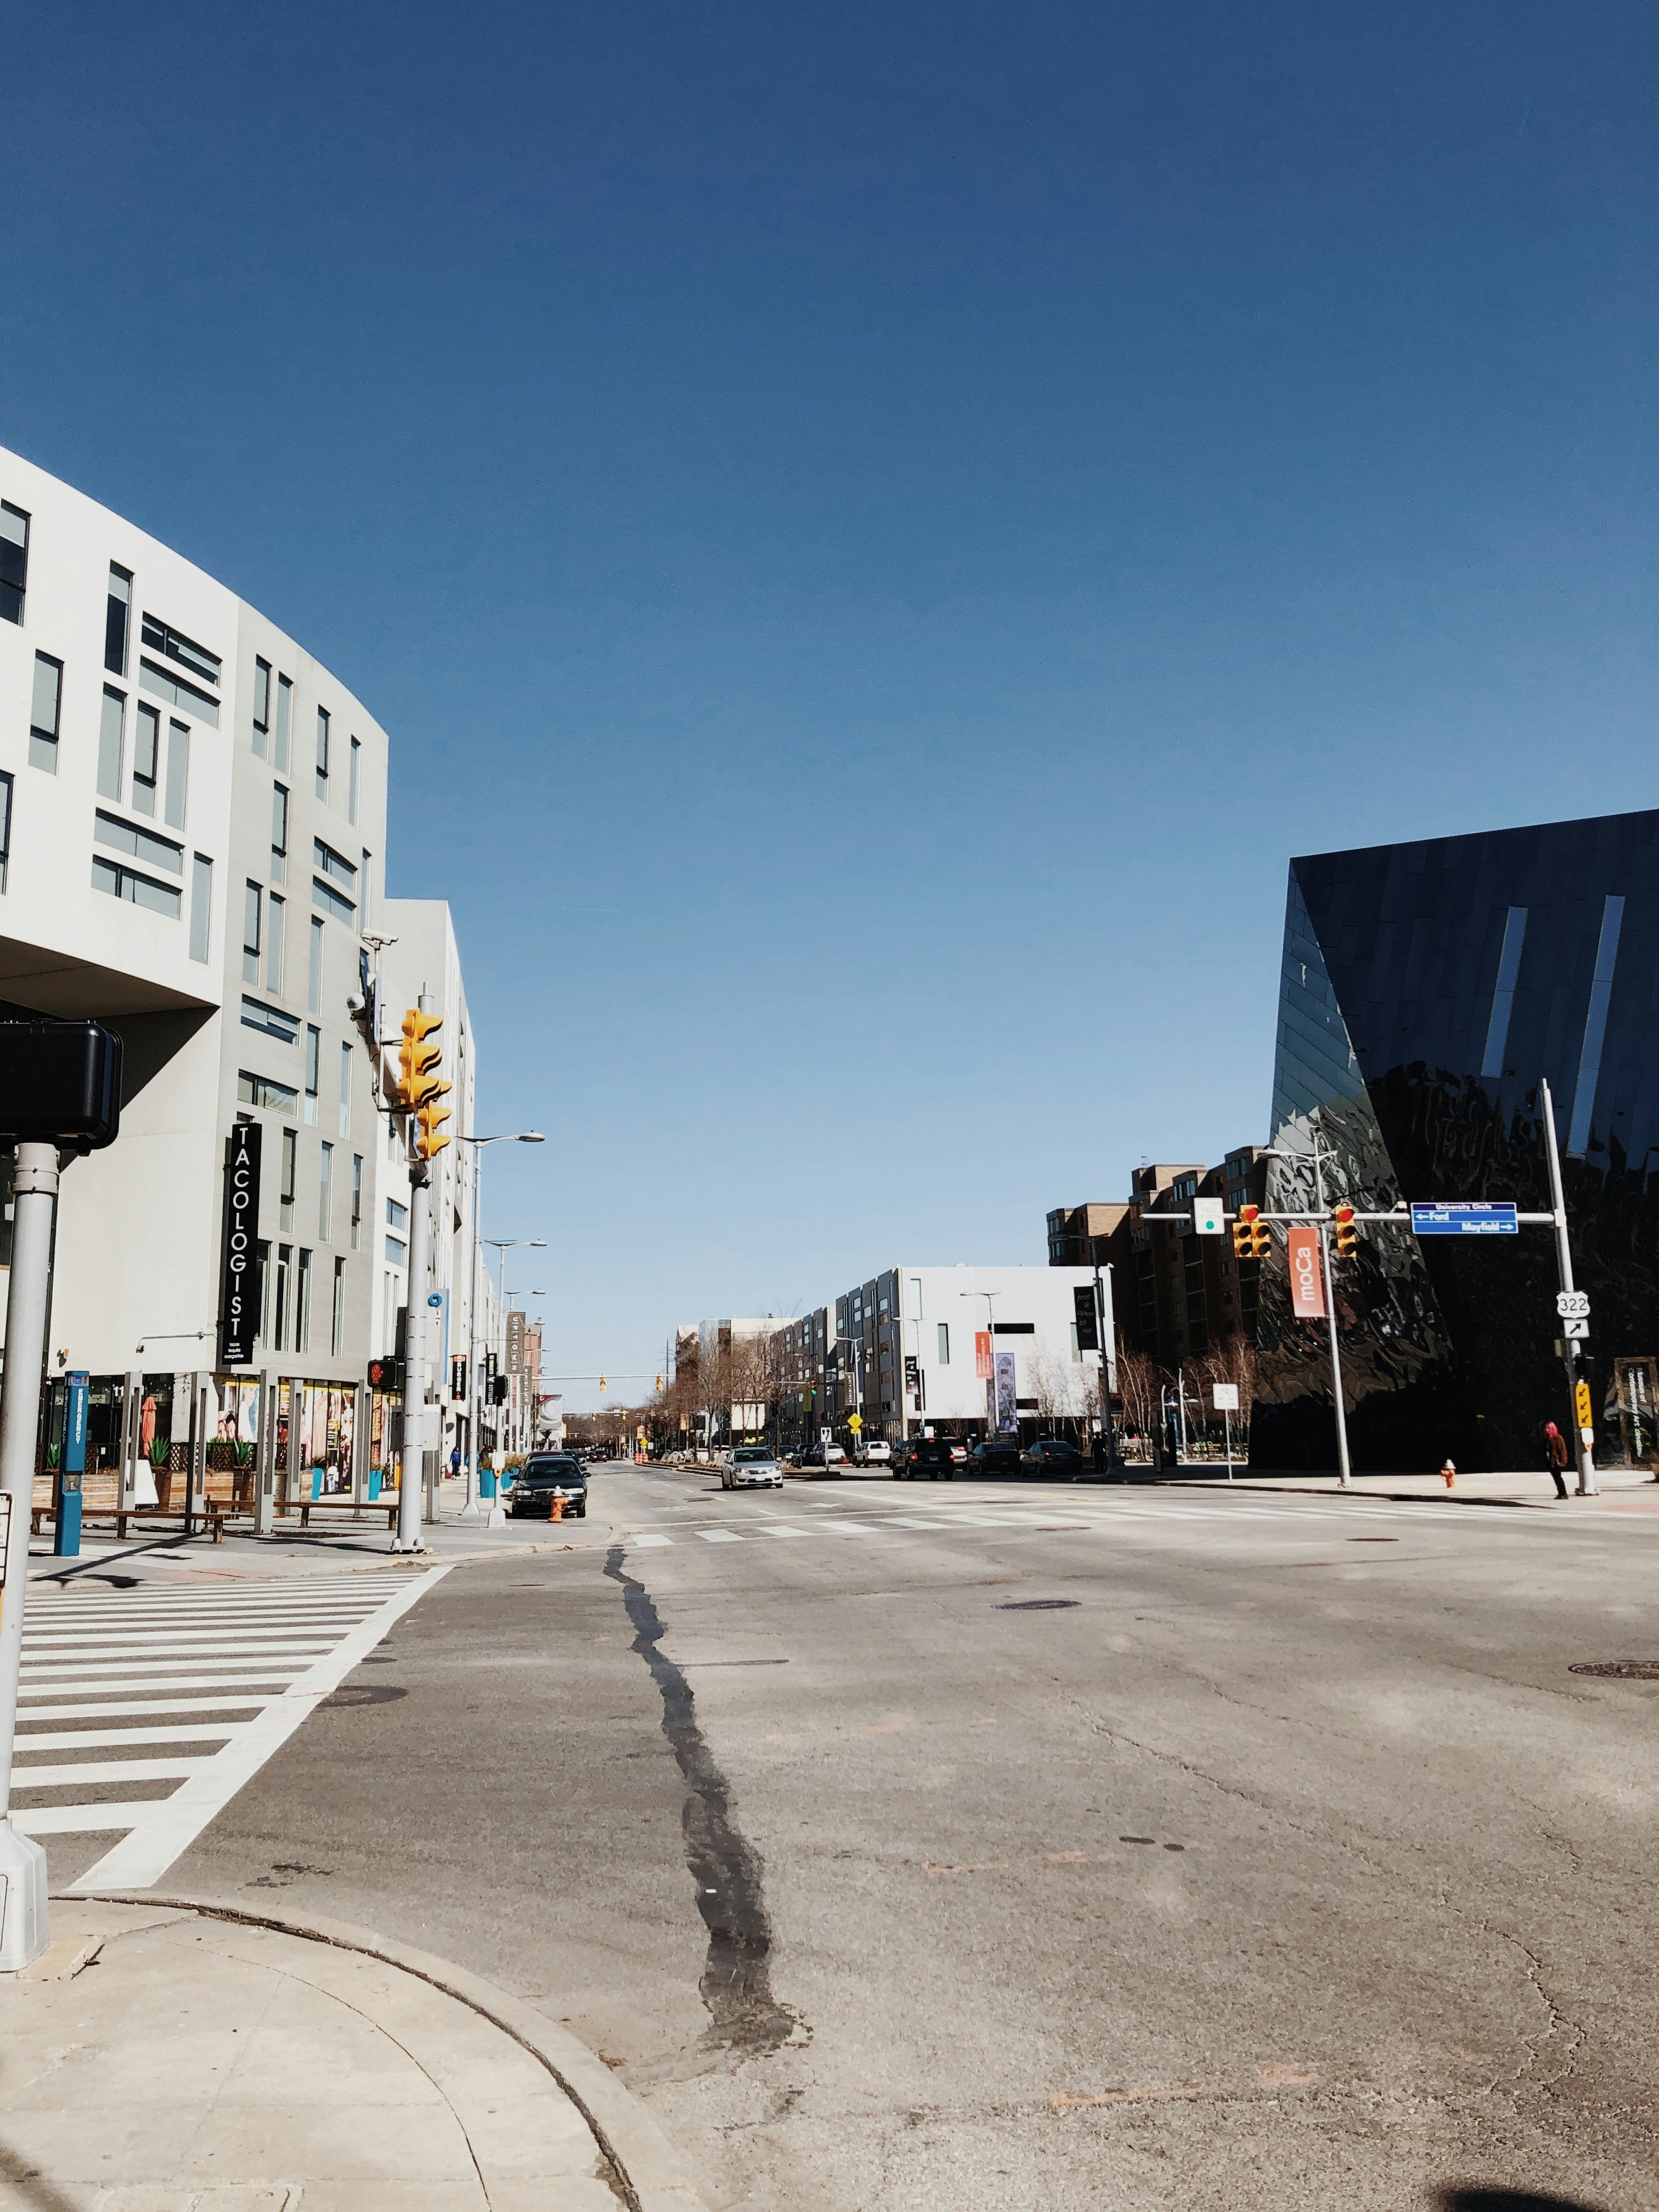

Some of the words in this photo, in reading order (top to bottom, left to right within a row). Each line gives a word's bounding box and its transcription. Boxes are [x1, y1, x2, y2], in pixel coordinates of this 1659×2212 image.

[1429, 1211, 1449, 1221] Ford
[230, 1127, 250, 1336] TACOLOGIST
[1461, 1222, 1500, 1233] Mayfield
[1295, 1247, 1316, 1301] moCa
[1076, 1294, 1091, 1303] free
[1560, 1298, 1587, 1311] 322
[1637, 1368, 1645, 1394] Museum
[1628, 1368, 1638, 1415] Contemporary
[1639, 1394, 1647, 1403] of
[75, 1388, 83, 1444] EMERGENCY
